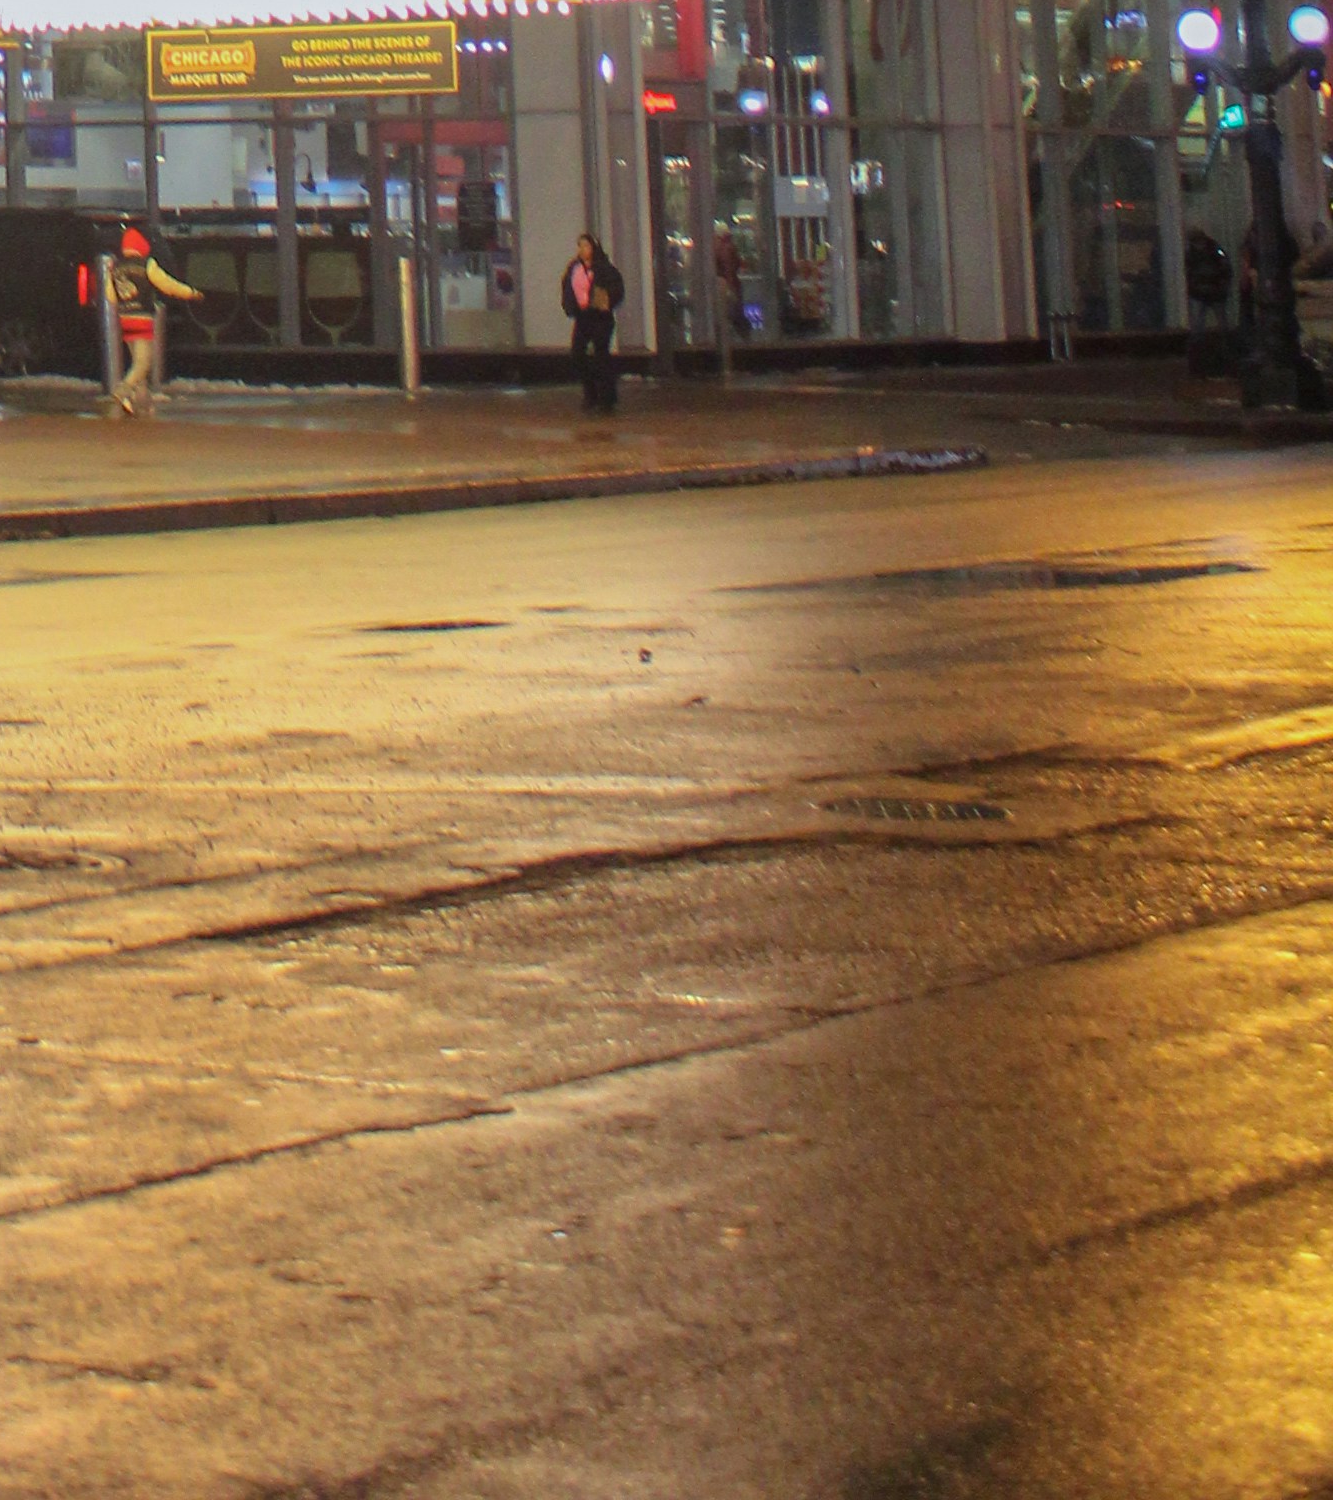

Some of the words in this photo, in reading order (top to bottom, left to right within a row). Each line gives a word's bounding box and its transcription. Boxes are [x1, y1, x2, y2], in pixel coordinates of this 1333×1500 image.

[291, 39, 309, 52] GO
[309, 37, 351, 51] BEHIND
[351, 36, 373, 50] THE
[373, 35, 415, 50] SCENES
[415, 35, 431, 48] OF
[171, 49, 245, 67] CHICAGO
[280, 55, 302, 68] THE
[303, 54, 342, 68] ICONIC
[341, 52, 392, 67] CHICAGO
[169, 72, 219, 88] MARQUEE
[219, 72, 248, 85] TOUR
